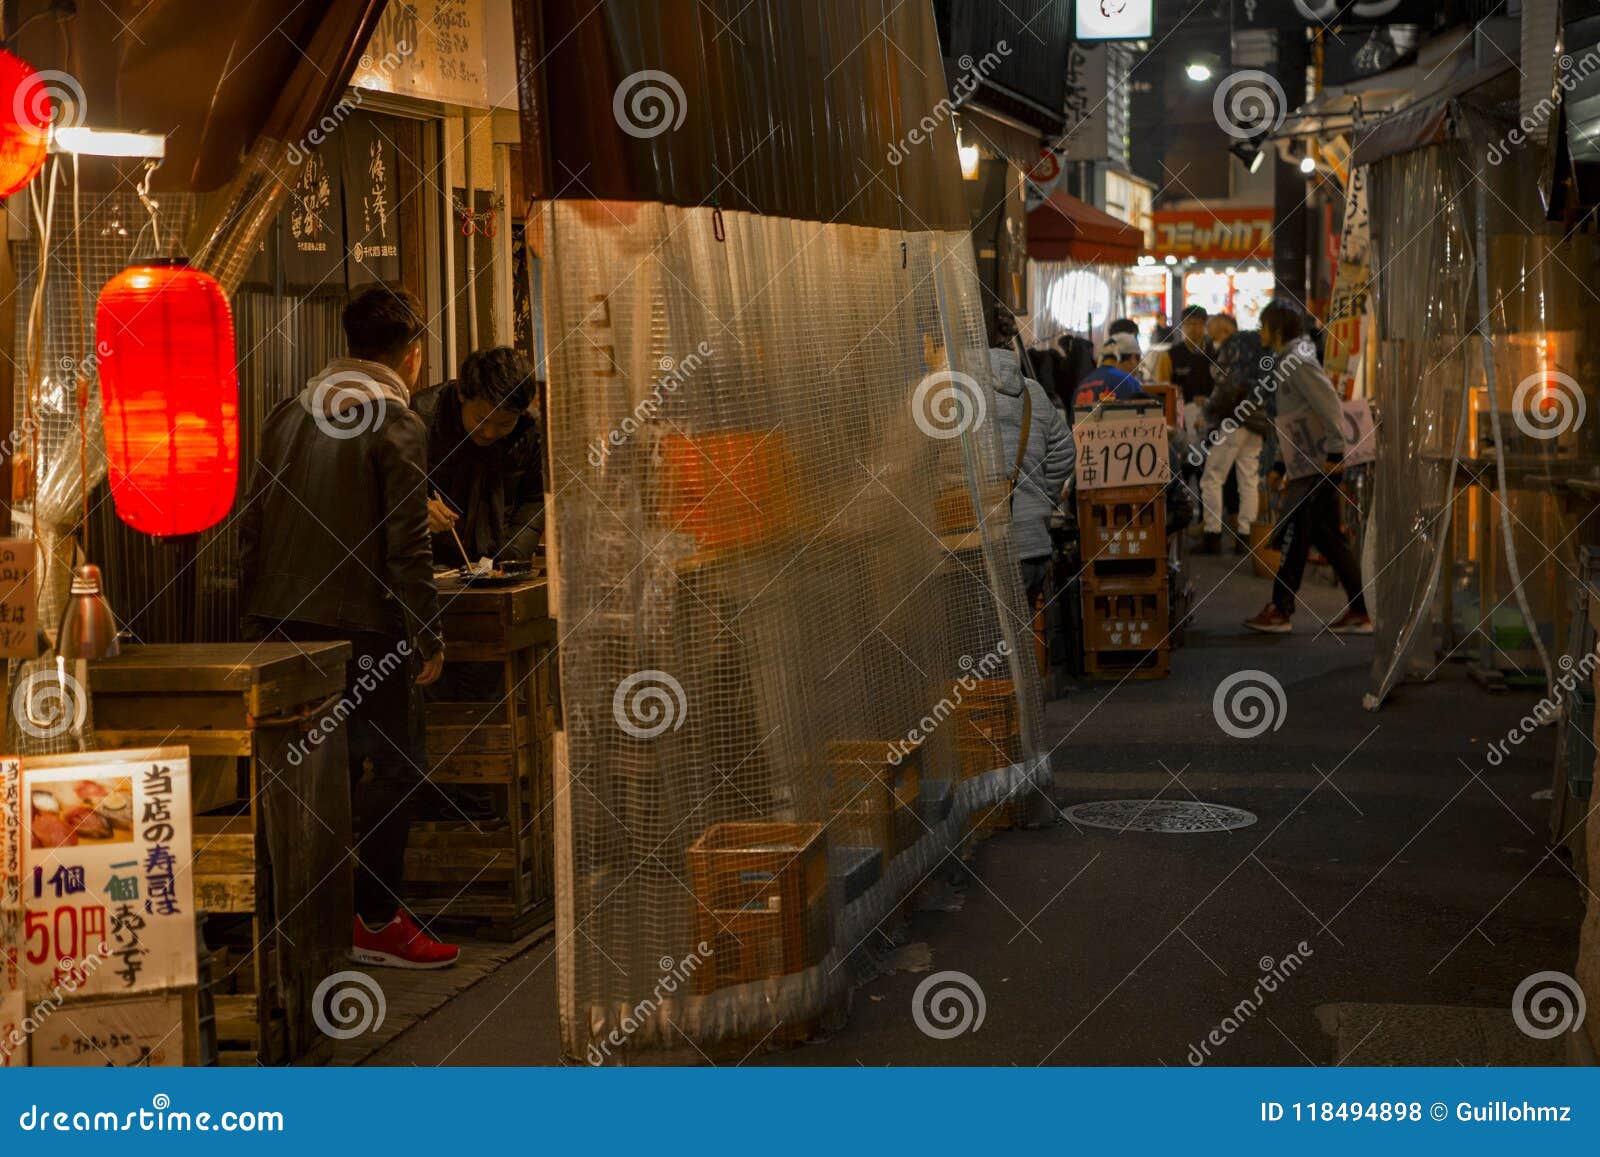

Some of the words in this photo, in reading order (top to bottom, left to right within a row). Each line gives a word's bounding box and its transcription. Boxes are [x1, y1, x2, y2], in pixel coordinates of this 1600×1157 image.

[1100, 442, 1156, 483] 190
[141, 764, 181, 916] 当店の寿司は
[25, 905, 107, 965] 50円
